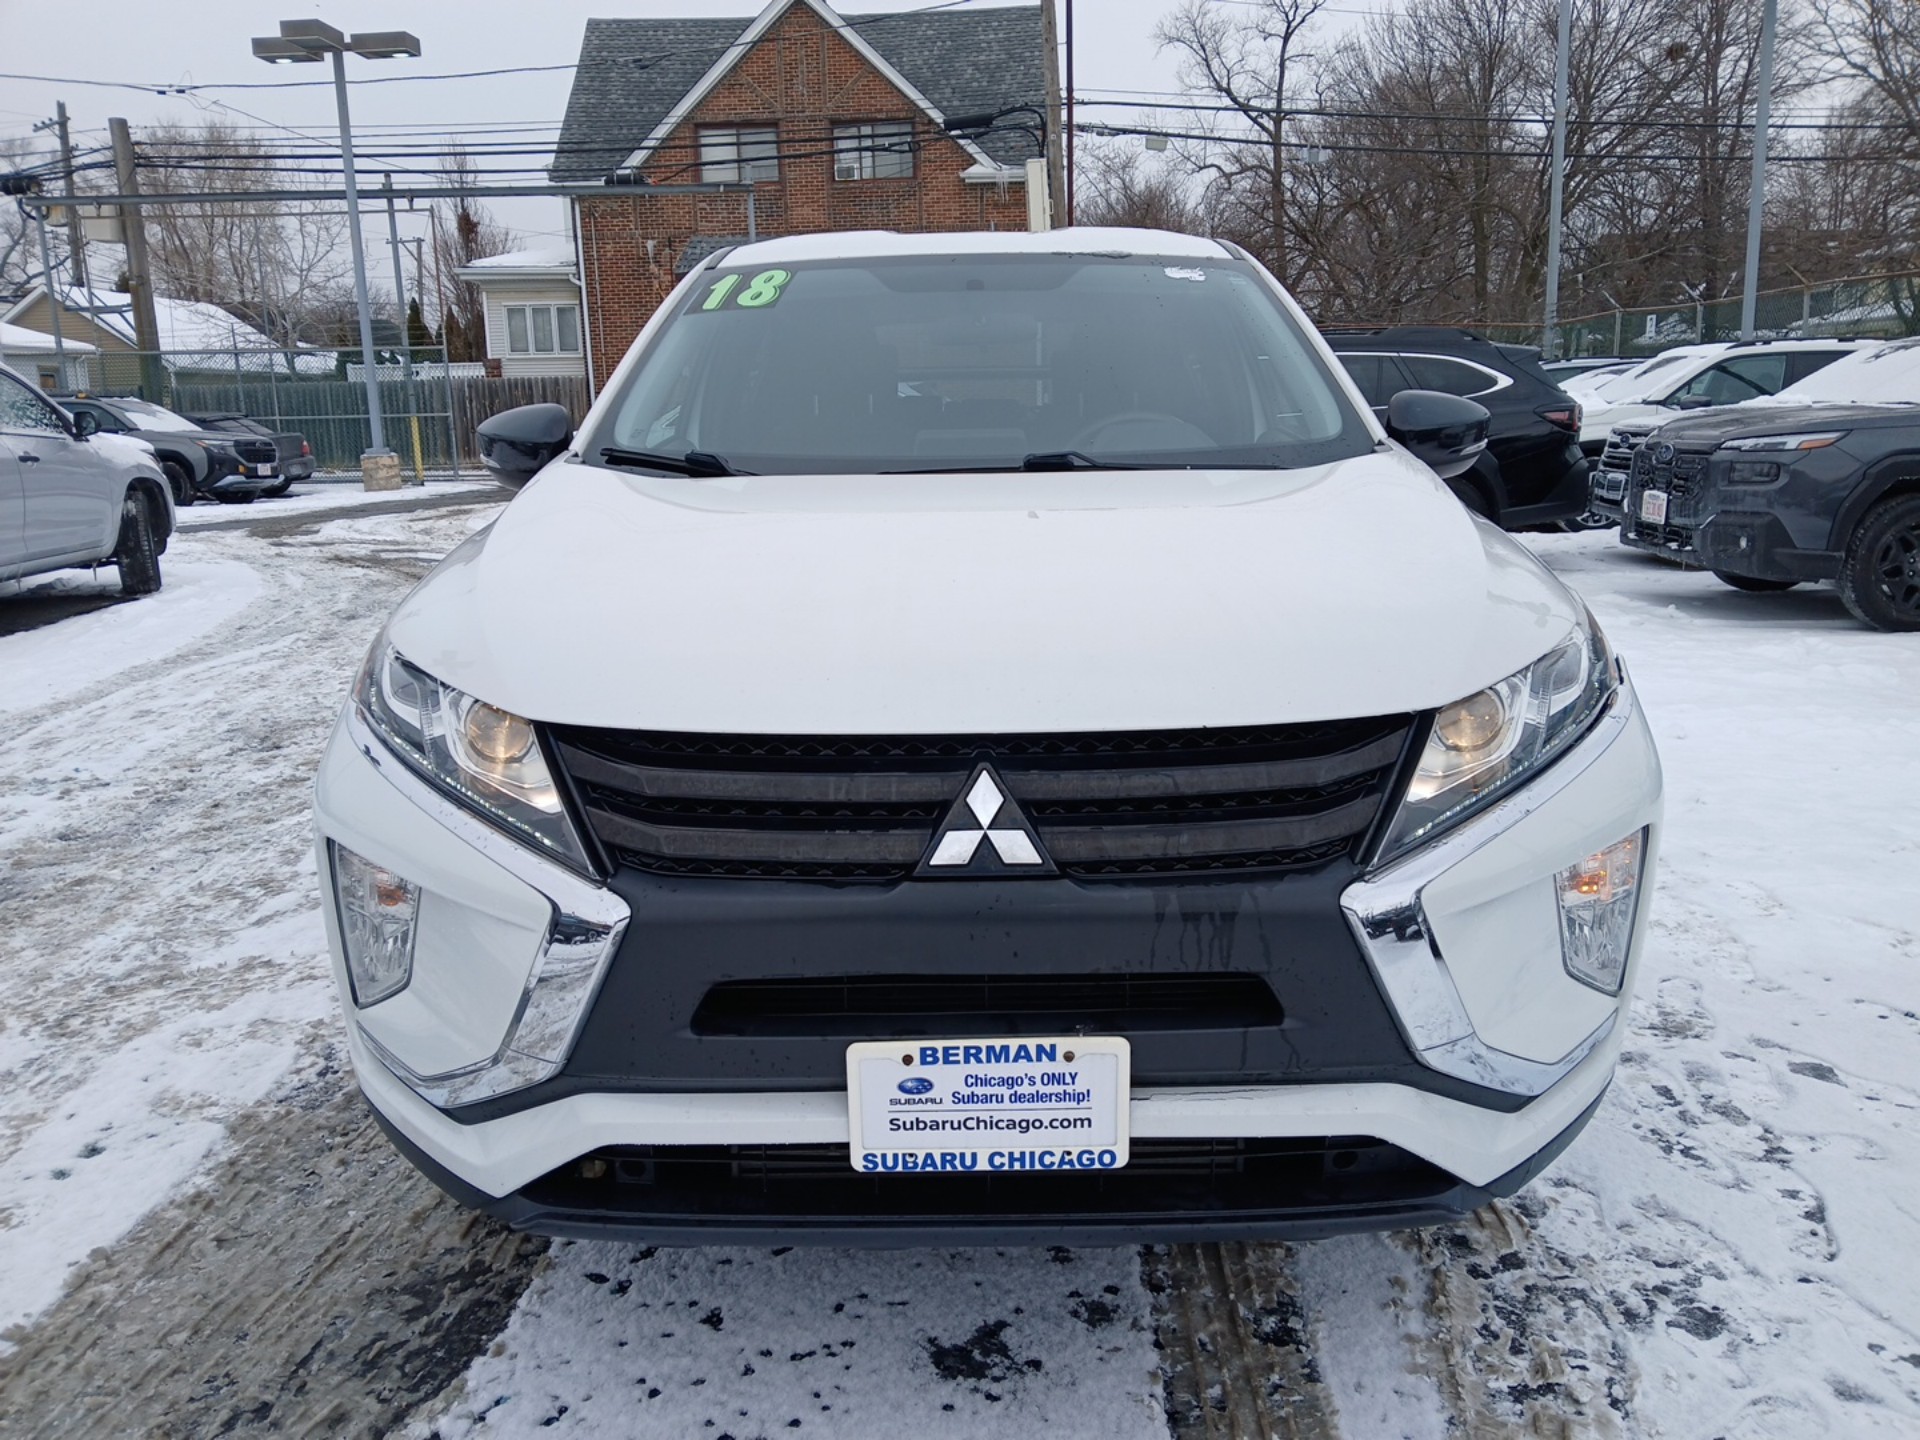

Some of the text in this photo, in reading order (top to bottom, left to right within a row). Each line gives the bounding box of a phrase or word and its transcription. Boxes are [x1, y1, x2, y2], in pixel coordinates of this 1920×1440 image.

[702, 269, 791, 311] 18
[919, 1043, 1057, 1066] BERMAN
[964, 1071, 1078, 1090] Chicago's ONLY
[889, 1097, 943, 1106] SUBARU
[951, 1088, 1091, 1105] Subaru dealership!
[889, 1115, 1092, 1134] SubaruChicago.com
[862, 1149, 1117, 1172] SUBARU CHICAGO
